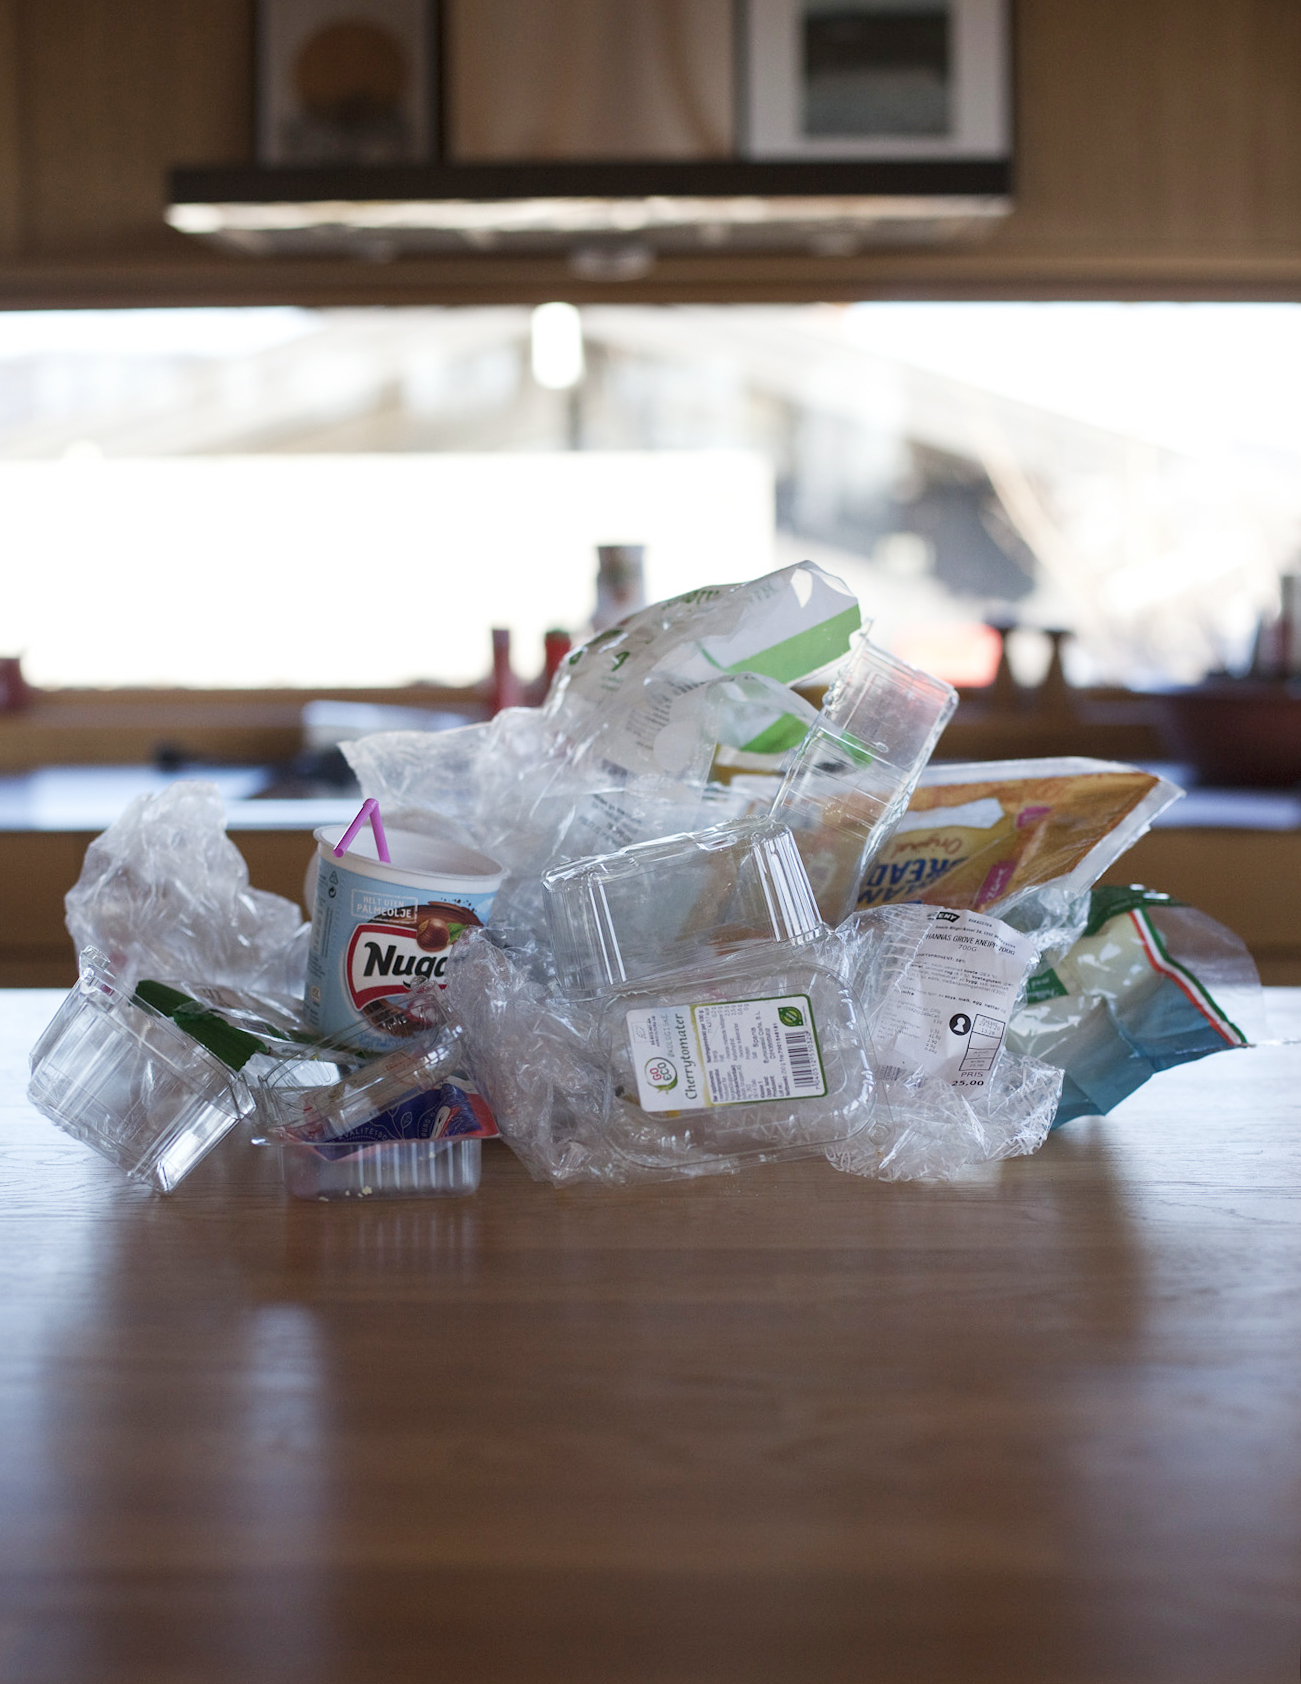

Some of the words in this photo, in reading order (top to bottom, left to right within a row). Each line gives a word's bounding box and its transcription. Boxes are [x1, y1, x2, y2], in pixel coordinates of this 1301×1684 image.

[356, 903, 411, 919] PALMEOLJE
[953, 935, 974, 945] GROVE
[958, 944, 977, 952] 700G
[675, 1014, 696, 1099] Cherrytomater
[649, 1067, 661, 1080] GO
[657, 1061, 671, 1080] ECO
